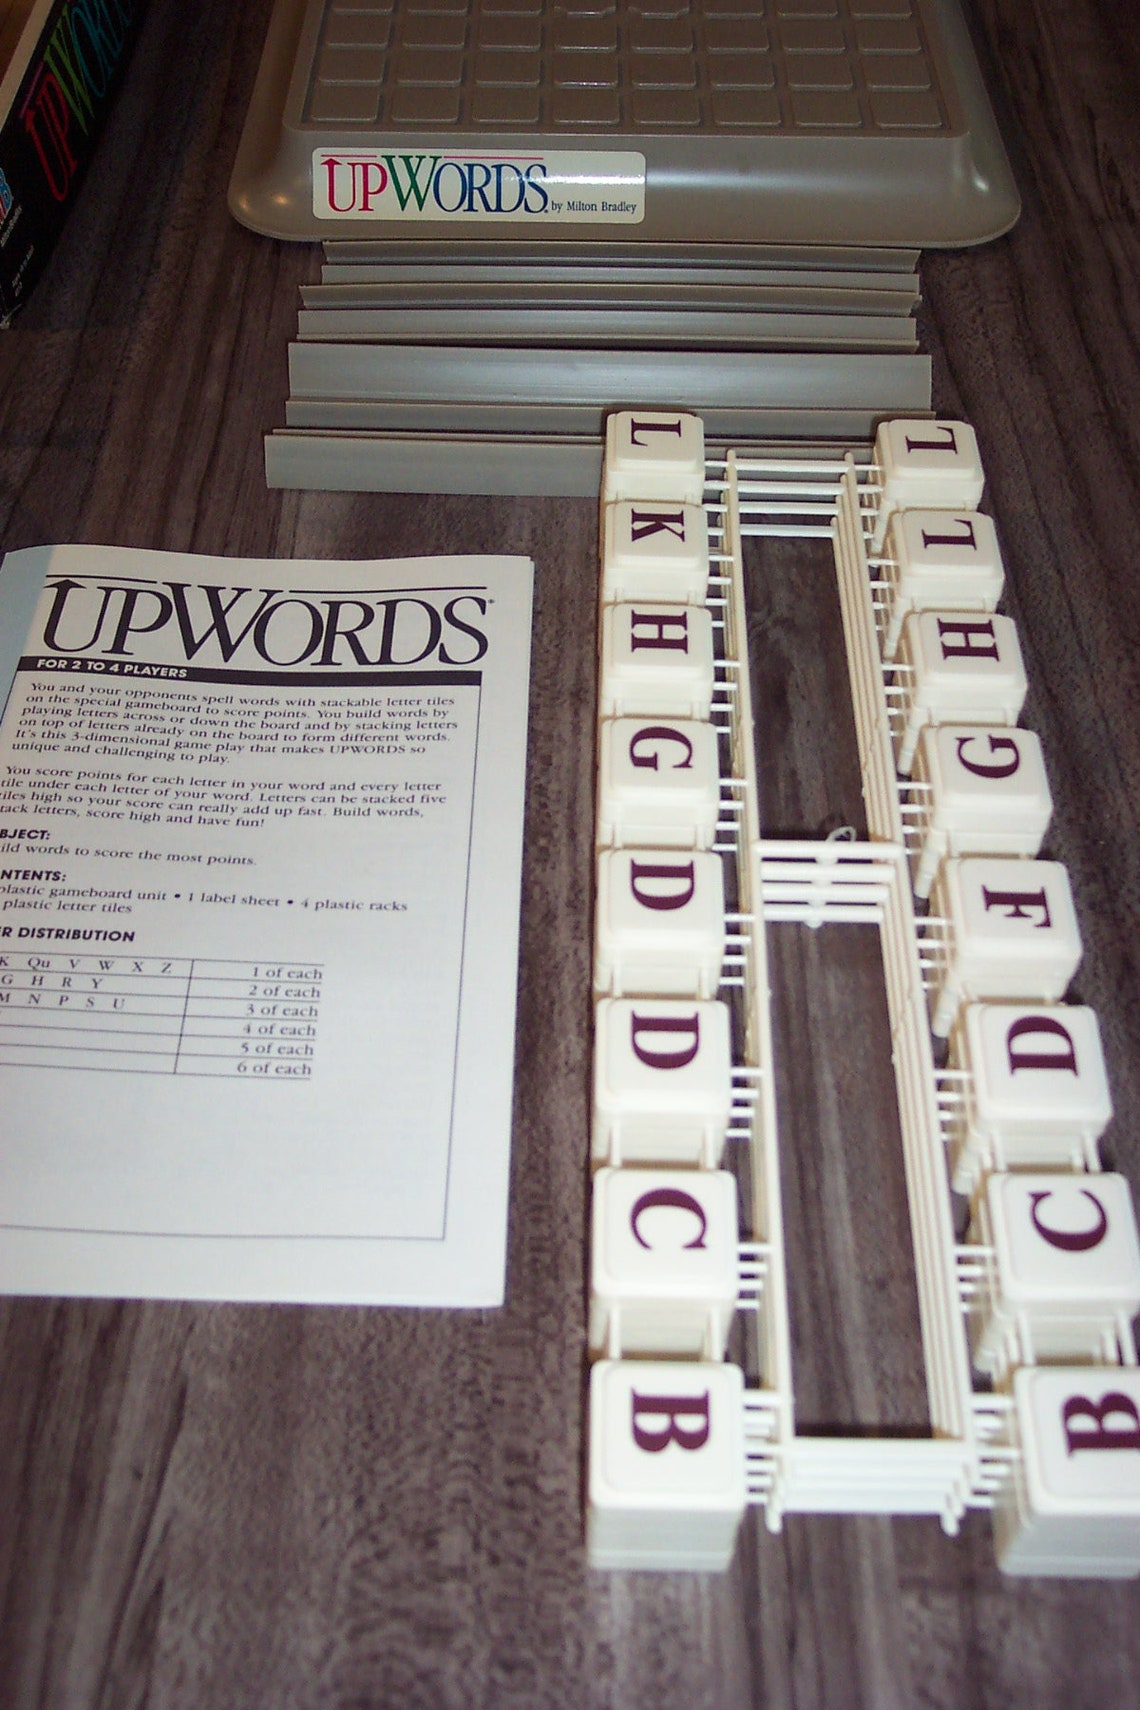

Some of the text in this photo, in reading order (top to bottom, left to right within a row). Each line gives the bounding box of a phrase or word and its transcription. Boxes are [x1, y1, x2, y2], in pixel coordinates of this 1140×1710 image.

[551, 200, 563, 213] by
[566, 200, 598, 212] Milton
[601, 201, 637, 214] Bradley
[630, 417, 682, 447] L
[905, 425, 959, 455] L
[630, 507, 686, 543] K
[921, 518, 978, 551] L
[630, 609, 689, 655] H
[936, 617, 1000, 663] H
[36, 658, 188, 679] FOR 2 TO 4 PLAYERS
[25, 695, 44, 703] on
[47, 693, 71, 704] the
[73, 697, 122, 707] special
[124, 700, 202, 714] gameboard
[205, 706, 220, 715] to
[223, 709, 260, 717] score
[317, 709, 342, 719] You
[346, 709, 382, 719] build
[386, 708, 429, 718] words
[433, 708, 449, 720] by
[31, 682, 455, 708] You and your opponents spell words with stackable letter tiles
[18, 719, 37, 727] on
[41, 718, 65, 730] top
[68, 719, 86, 729] of
[87, 719, 130, 732] letters
[133, 723, 185, 738] already
[189, 729, 208, 738] on
[212, 729, 235, 740] the
[238, 730, 280, 742] board
[283, 734, 298, 742] to
[301, 732, 336, 742] form
[339, 732, 399, 742] different
[20, 705, 458, 733] playing letters across down the board and by stacking letters
[11, 740, 61, 754] unique
[63, 743, 91, 754] and
[94, 745, 176, 762] challenging
[15, 728, 406, 754] It's this 3-dimensional game play that makes UPWORDS
[629, 726, 694, 772] G
[955, 733, 1020, 779] G
[0, 777, 24, 788] tile
[28, 779, 71, 790] under
[74, 782, 108, 793] each
[112, 783, 150, 796] letter
[174, 790, 208, 800] your
[259, 792, 306, 803] Letters
[310, 796, 336, 804] can
[340, 794, 358, 804] be
[362, 794, 416, 804] stacked
[420, 794, 446, 804] five
[6, 765, 32, 776] You
[34, 768, 74, 778] score
[76, 770, 122, 781] points
[126, 772, 148, 783] for
[151, 775, 185, 786] each
[189, 776, 227, 788] letter
[250, 782, 284, 792] your
[288, 781, 325, 791] word
[329, 781, 356, 791] and
[404, 781, 441, 791] letter
[30, 790, 63, 804] high
[87, 797, 122, 807] your
[125, 799, 164, 809] score
[168, 803, 194, 812] can
[198, 803, 238, 816] really
[242, 804, 270, 815] add
[274, 807, 293, 818] up
[333, 807, 371, 817] Build
[85, 809, 125, 820] score
[128, 810, 161, 824] high
[165, 814, 193, 824] and
[197, 814, 231, 826] have
[235, 817, 265, 827] fun!
[25, 844, 70, 855] words
[74, 847, 90, 856] to
[94, 849, 134, 859] score
[138, 849, 162, 861] the
[166, 853, 202, 863] most
[630, 858, 695, 911] D
[2, 898, 132, 913] plastic letter tiles
[48, 887, 133, 900] gameboard
[137, 891, 167, 901] unit
[200, 892, 236, 904] label
[241, 895, 279, 907] sheet
[314, 899, 364, 912] plastic
[370, 900, 408, 911] racks
[981, 884, 1053, 928] F
[17, 926, 136, 943] DISTRIBUTION
[265, 968, 283, 978] of
[287, 968, 322, 980] each
[631, 1010, 700, 1070] D
[1007, 1016, 1078, 1078] D
[237, 1061, 311, 1075] 6 of each
[630, 1187, 707, 1250] C
[1027, 1189, 1108, 1253] C
[630, 1386, 710, 1453] B
[1061, 1391, 1140, 1457] B
